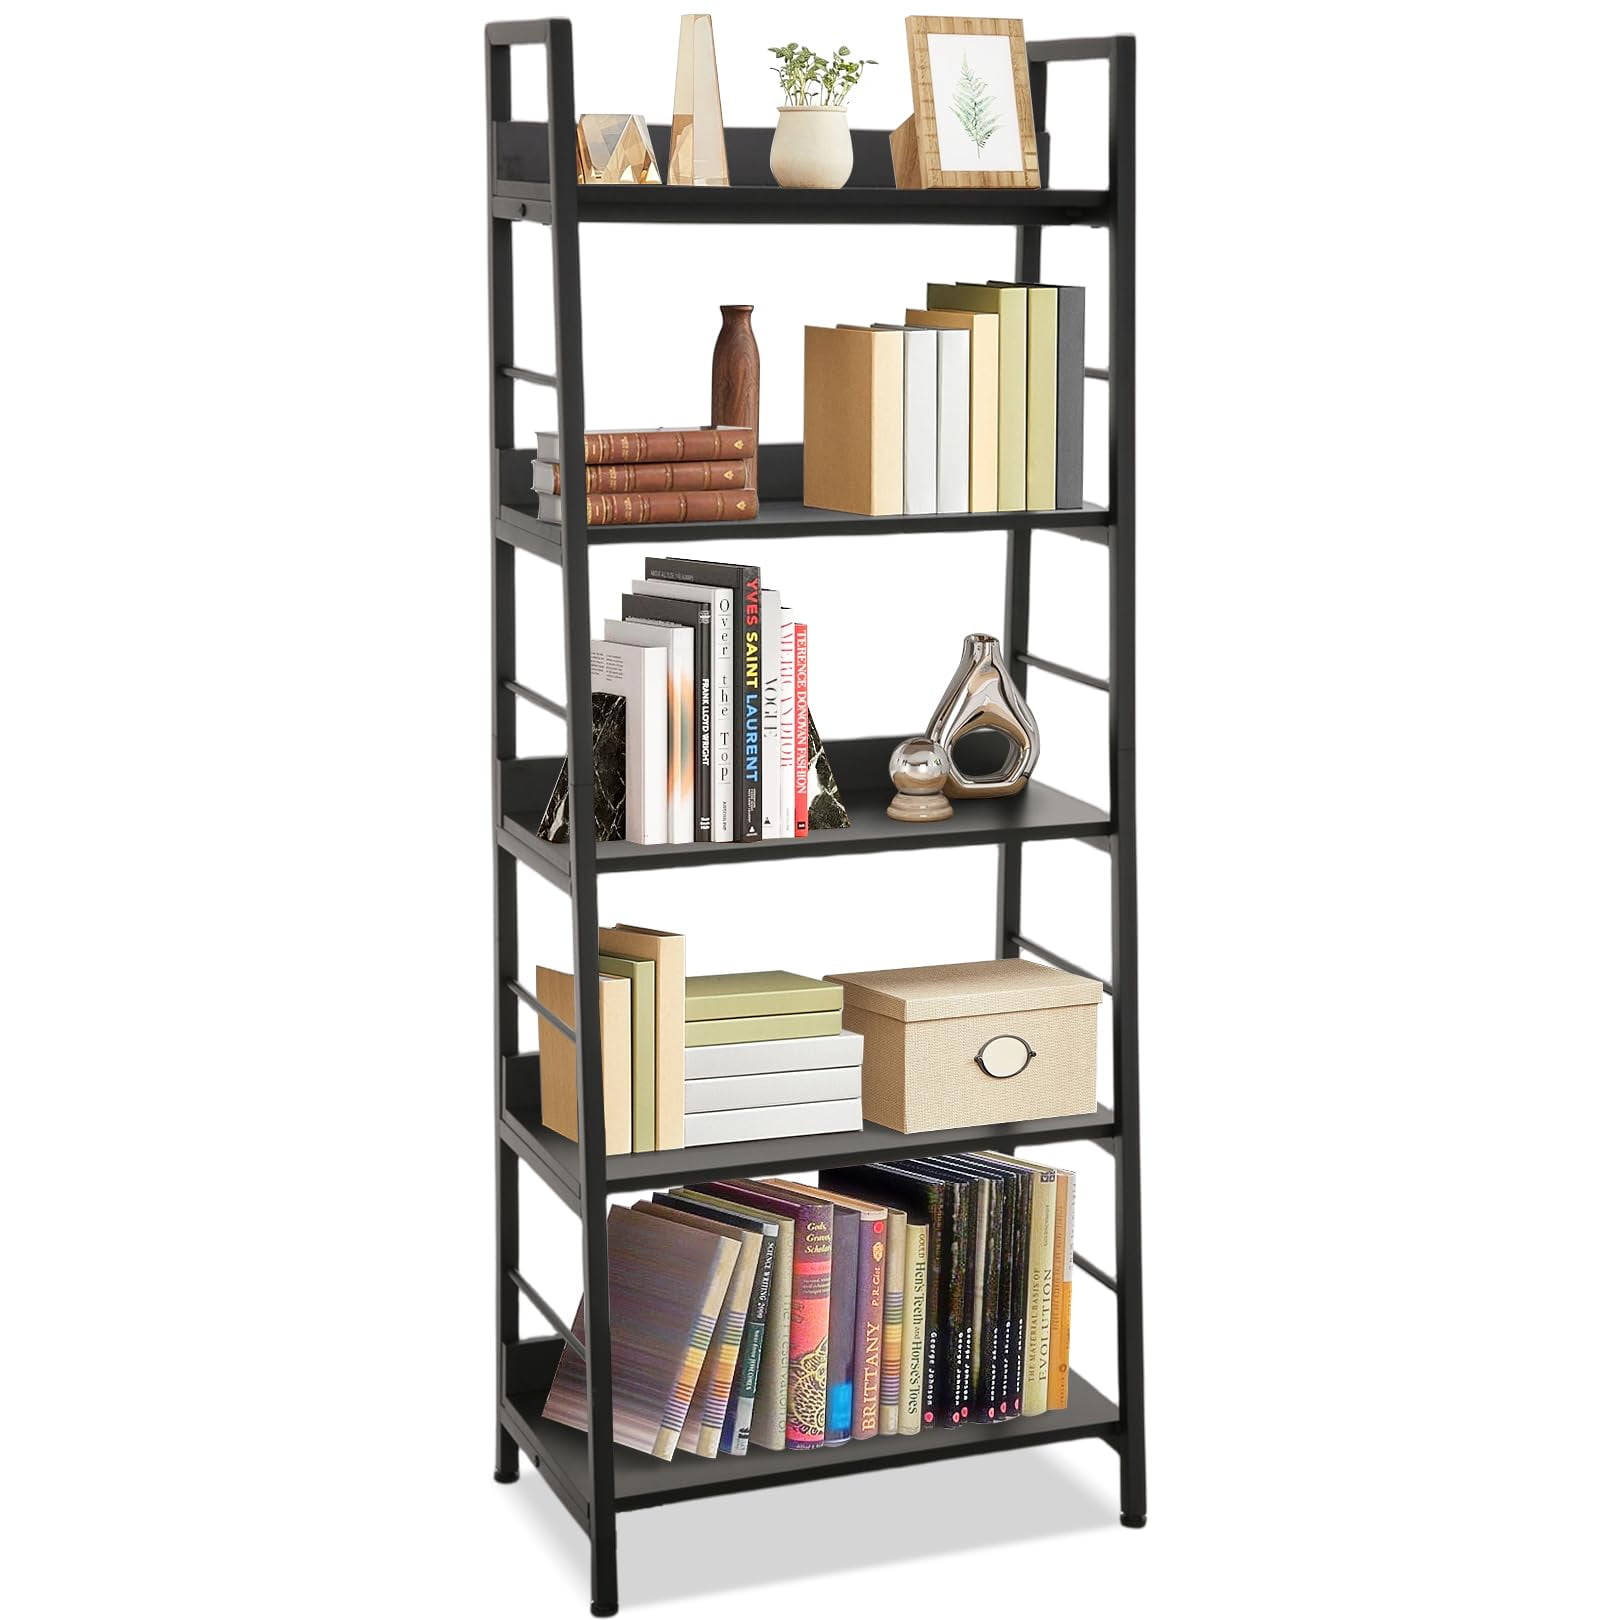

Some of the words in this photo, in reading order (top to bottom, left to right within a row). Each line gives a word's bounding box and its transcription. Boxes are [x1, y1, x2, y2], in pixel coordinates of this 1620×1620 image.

[745, 577, 759, 626] YVES
[719, 598, 730, 655] Over
[746, 631, 759, 688] SAINT
[796, 630, 807, 688] TERENCE
[702, 678, 710, 705] FRANK
[721, 675, 729, 716] the
[764, 678, 778, 738] VOGUE
[702, 705, 710, 732] LLOYD
[745, 694, 758, 782] LAURENT
[796, 691, 807, 745] DONOVAN
[702, 732, 710, 766] WRIGHT
[719, 732, 729, 781] Top
[780, 722, 793, 767] DIOR
[796, 747, 807, 794] FASHION
[764, 1242, 775, 1269] SCIENCE
[918, 1233, 926, 1258] GOULD
[759, 1270, 771, 1301] WRITING
[914, 1261, 926, 1293] Hen's
[1031, 1282, 1040, 1310] BASIS
[912, 1293, 925, 1325] Teeth
[1038, 1268, 1052, 1381] EVOLUTION
[928, 1331, 938, 1365] George
[1028, 1313, 1038, 1361] MATERIAL
[862, 1321, 880, 1431] BRITTANY
[909, 1341, 922, 1385] Horse's
[1028, 1362, 1036, 1382] THE
[907, 1386, 920, 1415] Toes
[927, 1368, 935, 1406] Johnson
